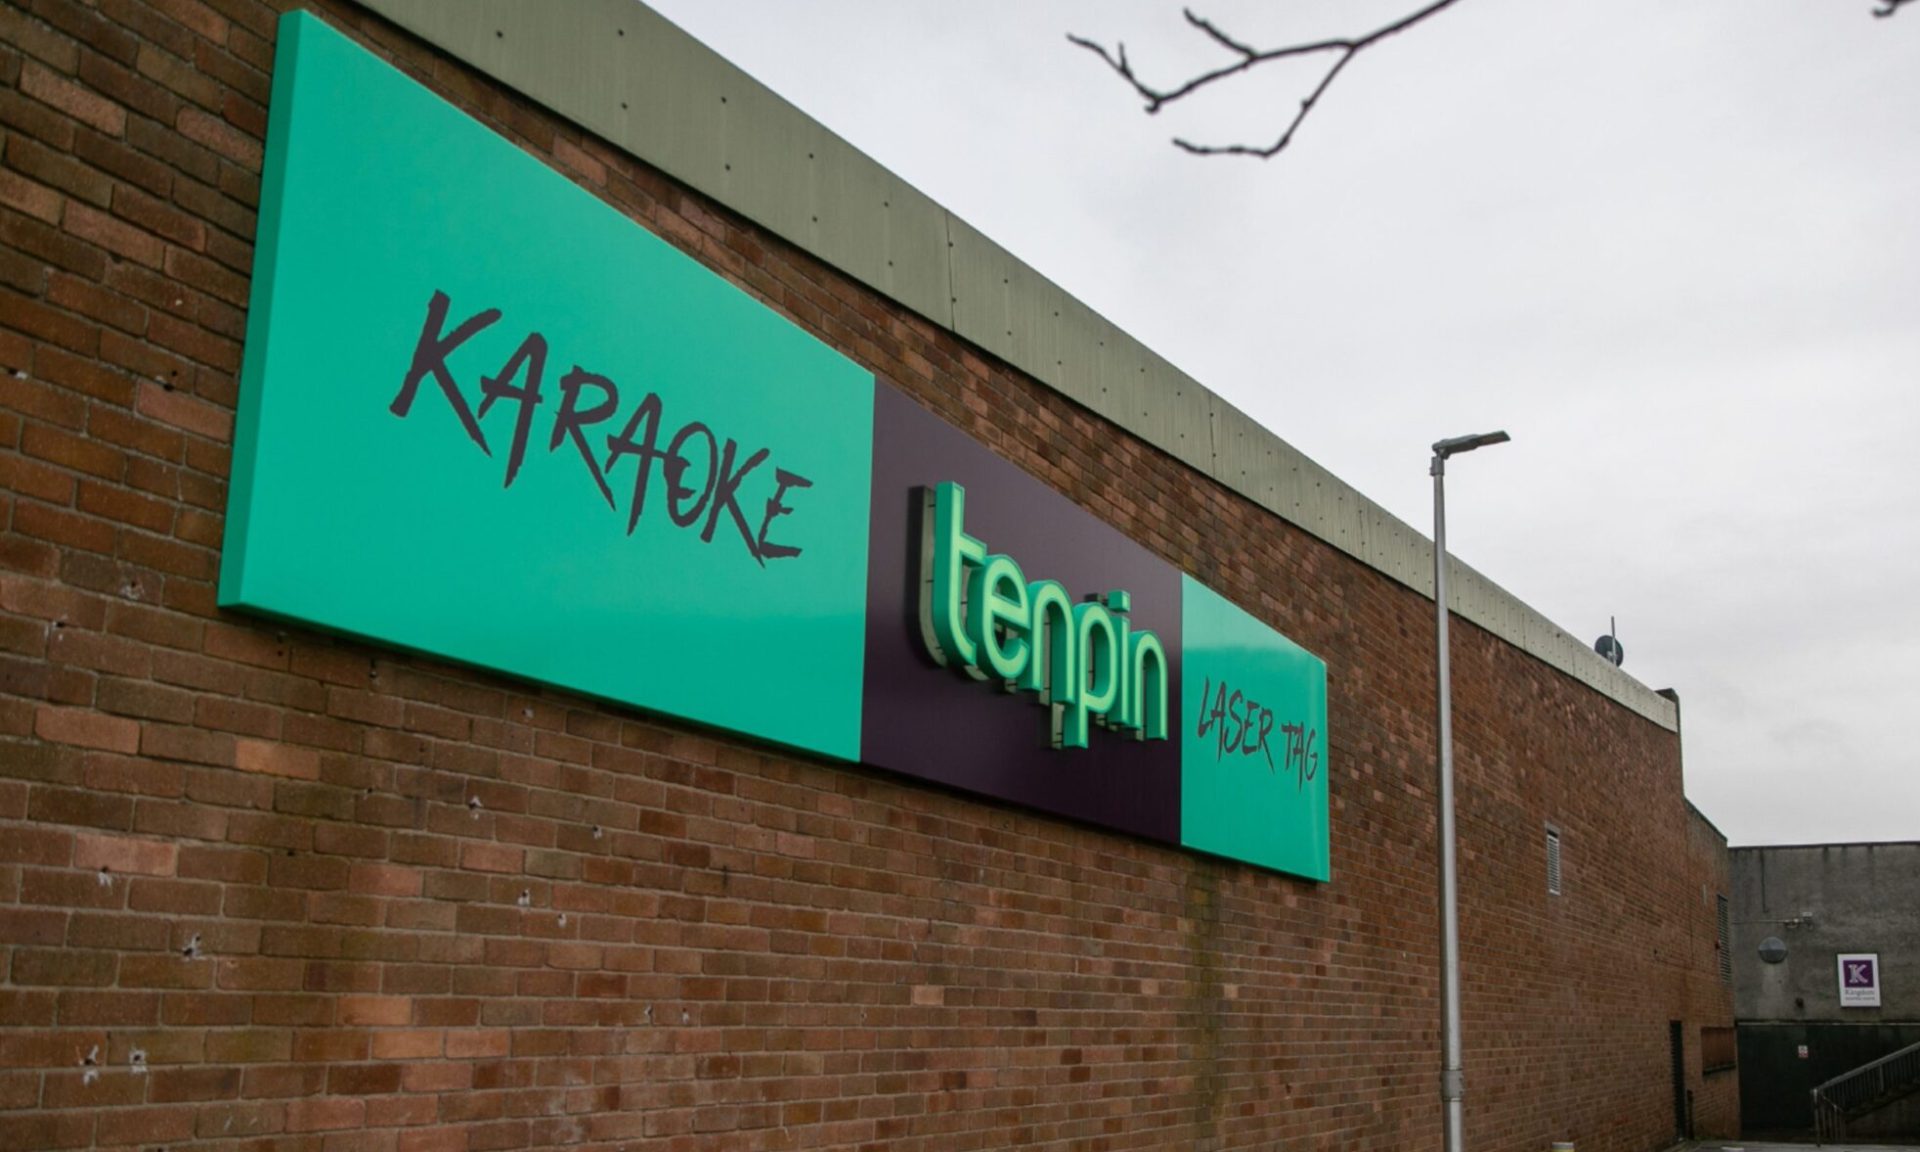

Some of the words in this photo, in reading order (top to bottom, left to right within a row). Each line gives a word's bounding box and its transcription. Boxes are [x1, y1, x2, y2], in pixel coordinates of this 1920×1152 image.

[389, 289, 813, 568] KARAOKE
[933, 481, 1168, 749] tenpin
[1198, 676, 1275, 774] LASER
[1281, 720, 1318, 793] TAG
[1848, 963, 1868, 984] K
